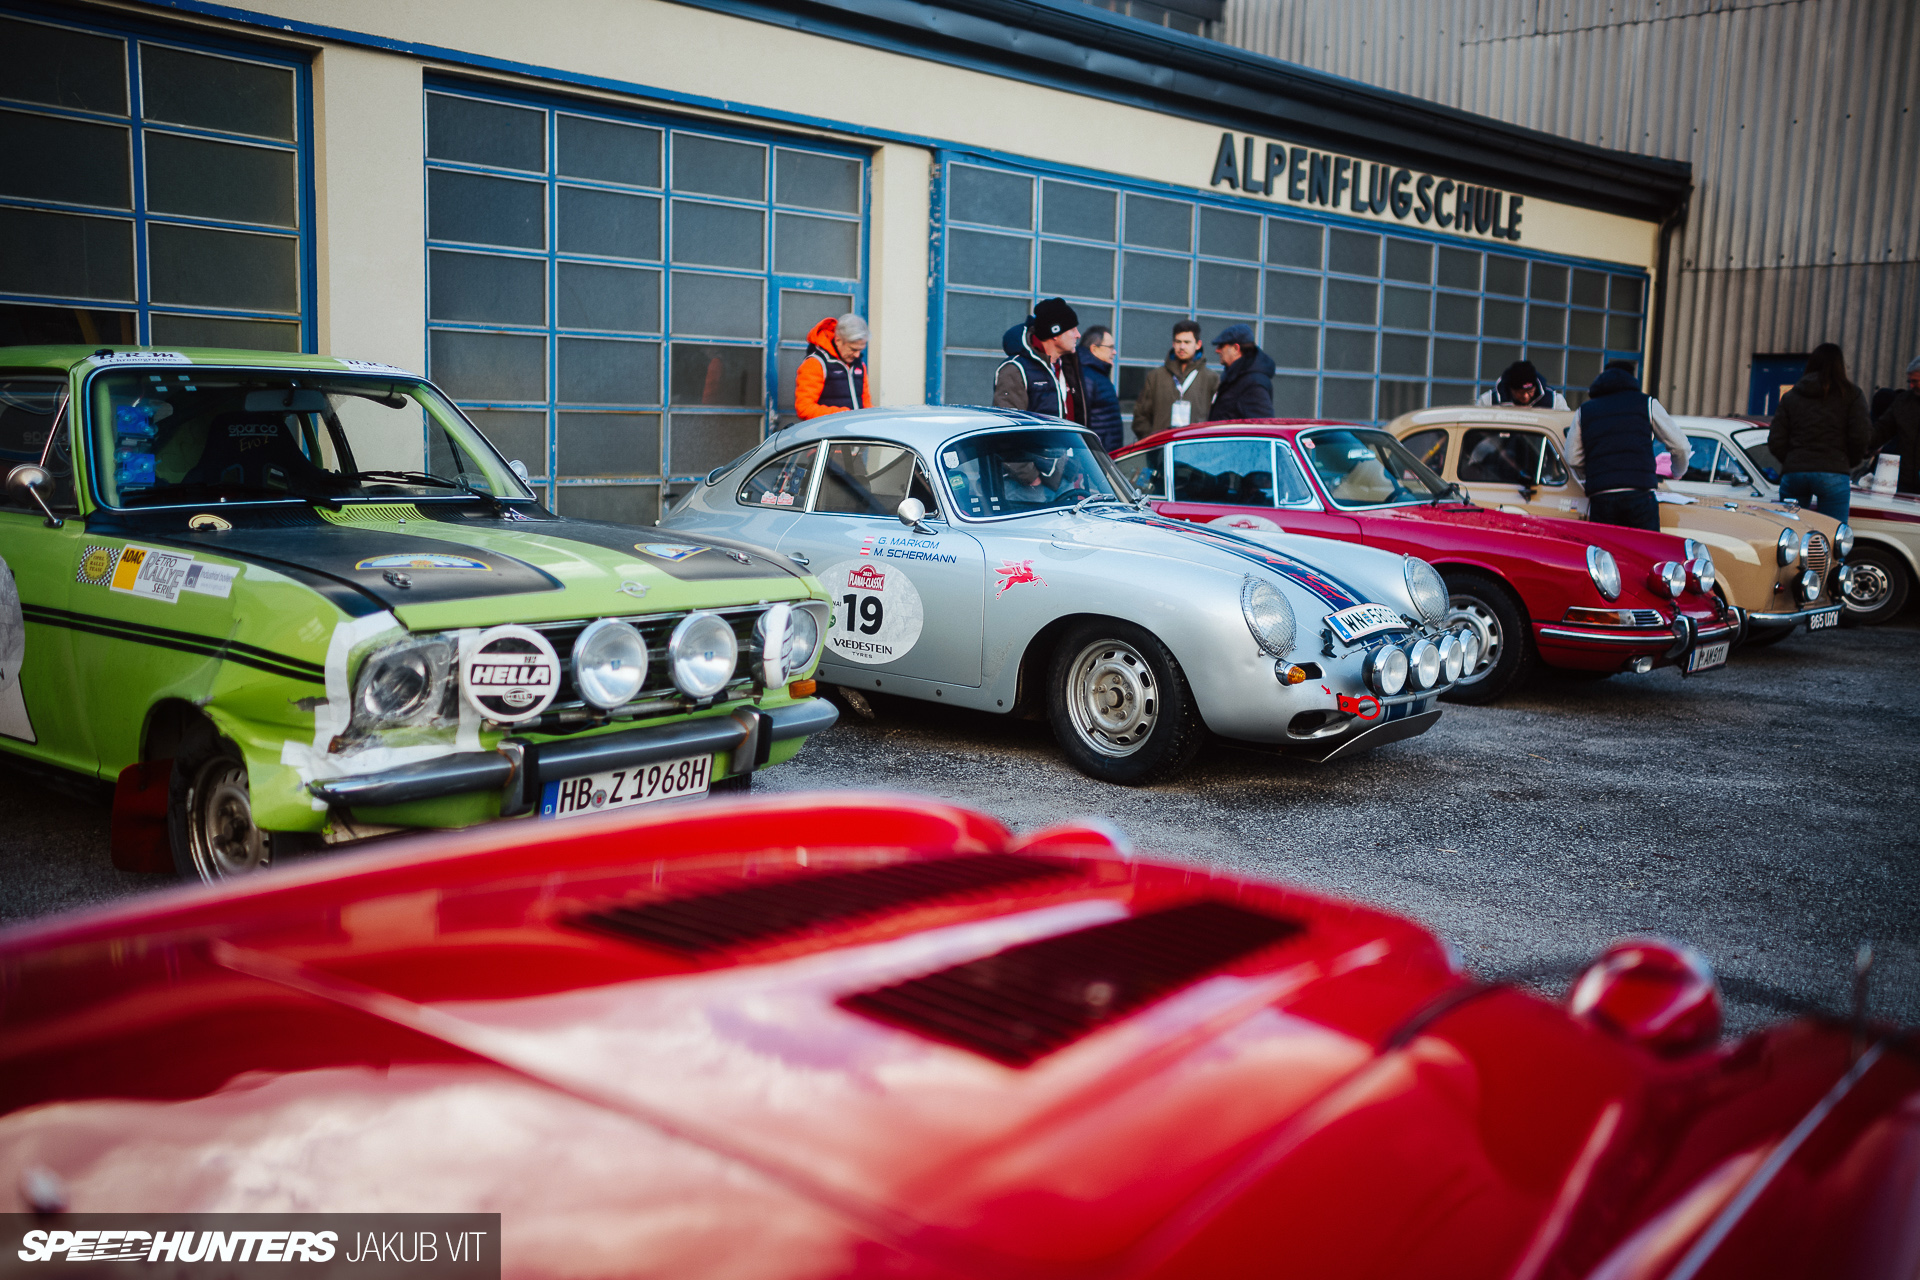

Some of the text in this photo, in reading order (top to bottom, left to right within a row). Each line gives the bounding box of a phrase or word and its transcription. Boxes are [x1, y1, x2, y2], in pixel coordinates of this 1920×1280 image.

[1210, 132, 1524, 241] ALPENFLUGSCHULE
[228, 424, 278, 437] sparco
[878, 536, 940, 550] G. MARKOM
[120, 549, 145, 565] ADAC
[873, 547, 958, 564] M. SCHERMANN
[849, 572, 884, 590] PLANAI-CLASSIC
[843, 593, 884, 636] 19
[1341, 612, 1369, 633] WN
[1810, 614, 1825, 630] 865
[833, 637, 893, 655] VREDESTEIN
[852, 651, 873, 659] TYRES
[471, 665, 551, 685] HELLA
[544, 757, 707, 815] D HB Z 1968H
